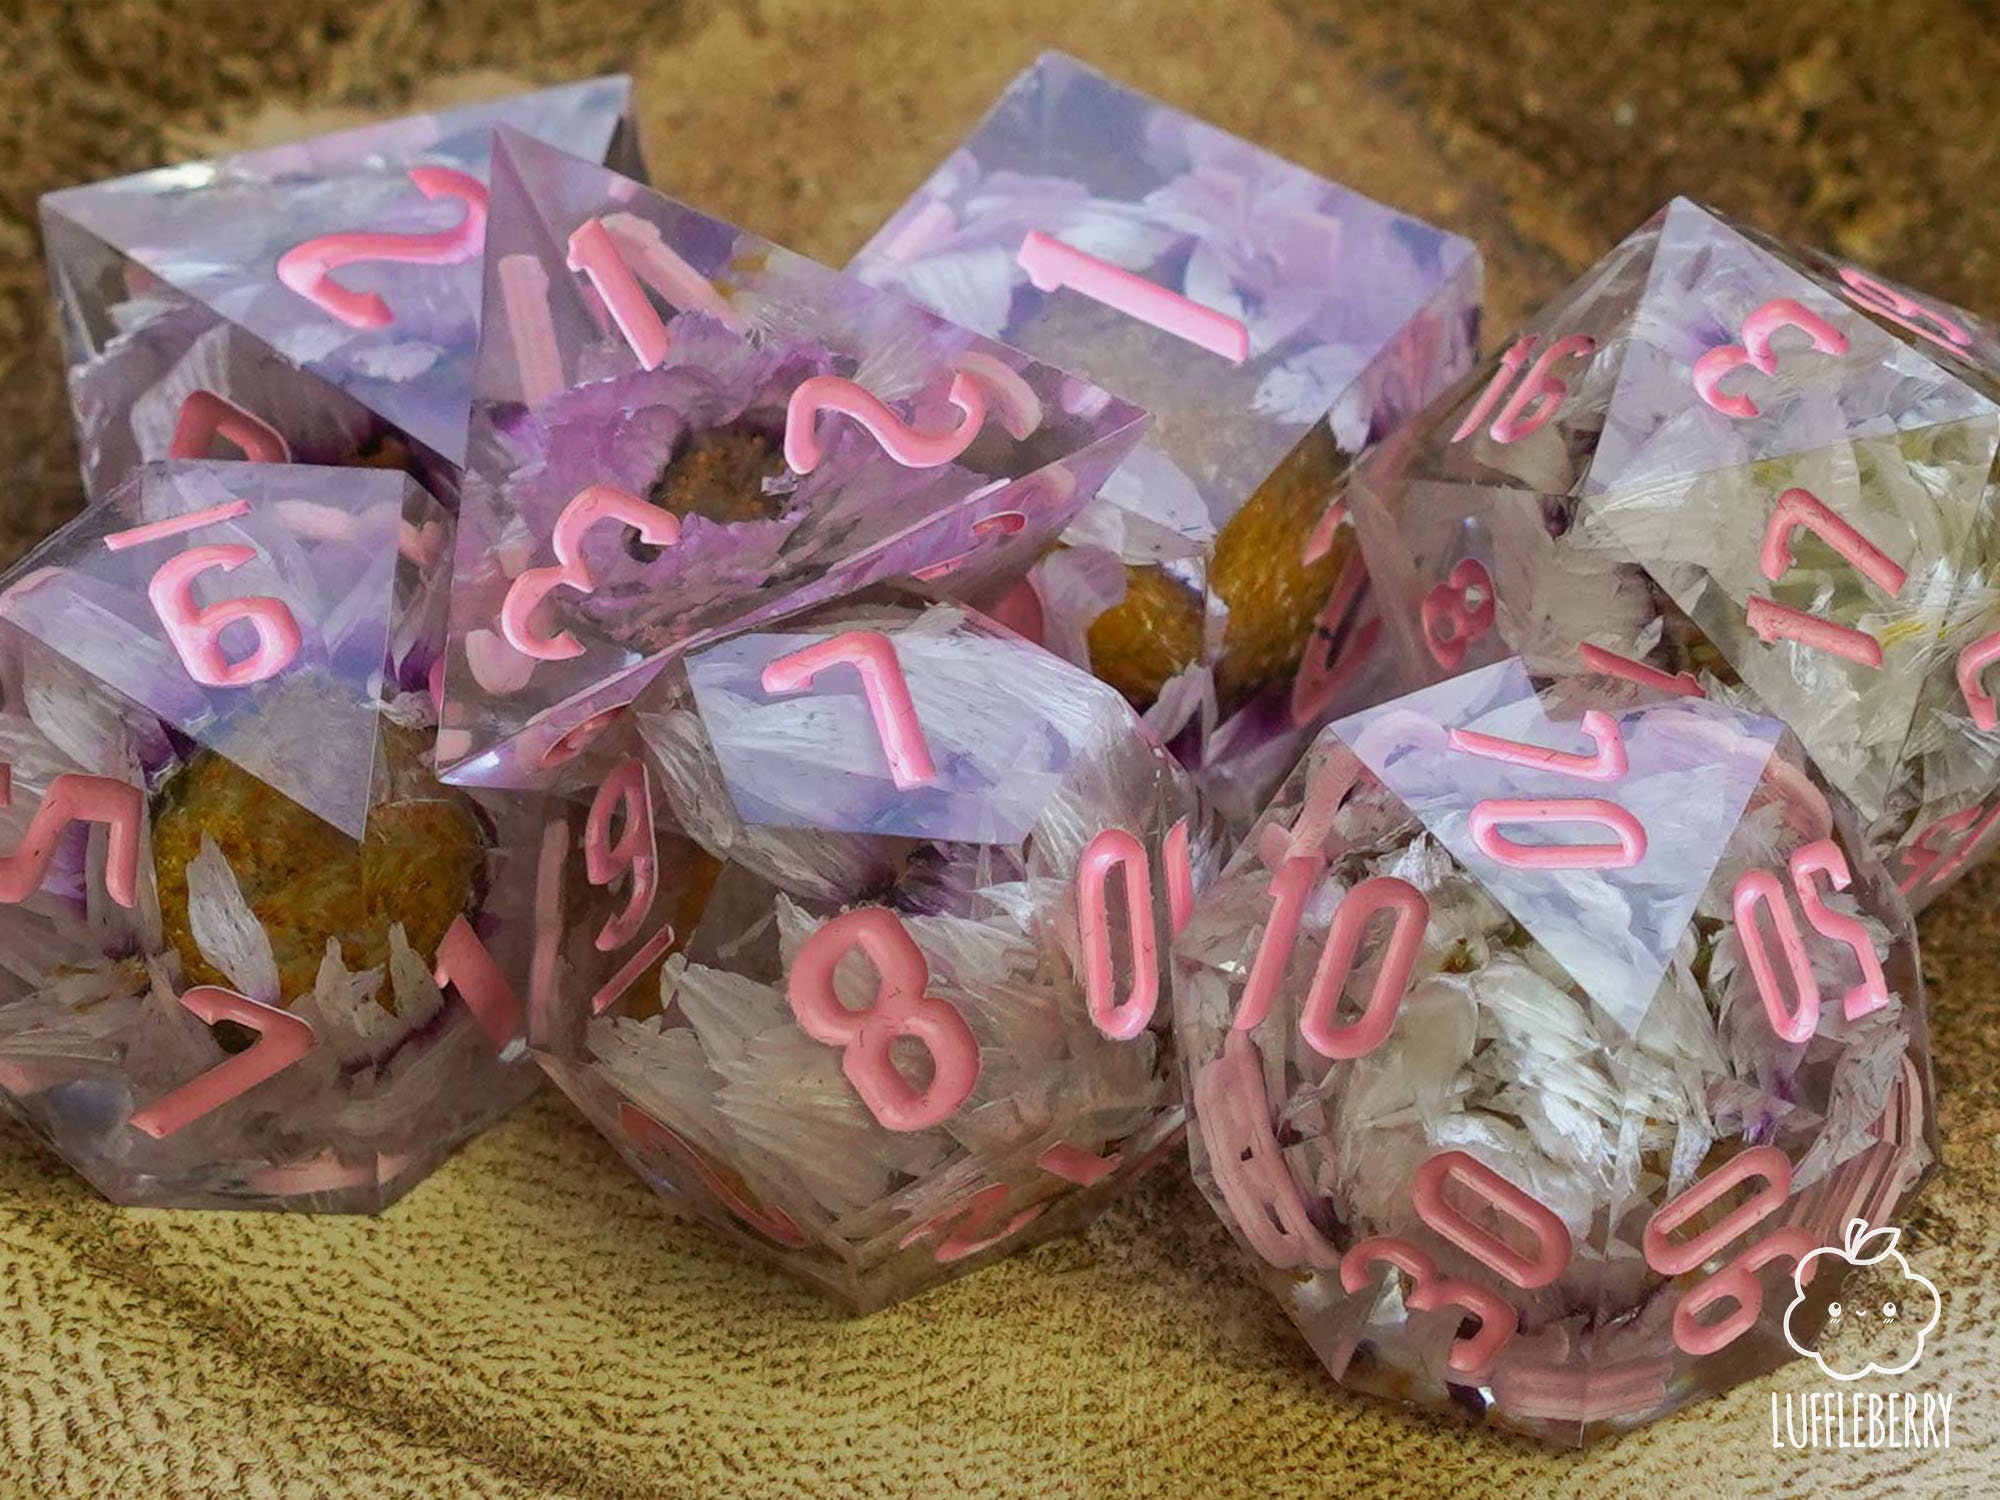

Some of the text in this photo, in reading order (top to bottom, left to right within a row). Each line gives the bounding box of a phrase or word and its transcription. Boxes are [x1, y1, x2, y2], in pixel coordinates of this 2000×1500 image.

[278, 167, 490, 328] 2
[1017, 228, 1250, 365] 1
[784, 369, 986, 475] 2
[1450, 333, 1596, 444] 16
[1692, 298, 1850, 418] 3
[501, 484, 682, 661] 3
[762, 629, 936, 791] 7
[787, 905, 983, 1132] 8
[1235, 852, 1430, 1061] 10
[129, 984, 316, 1139] 7
[1340, 1148, 1573, 1373] 30
